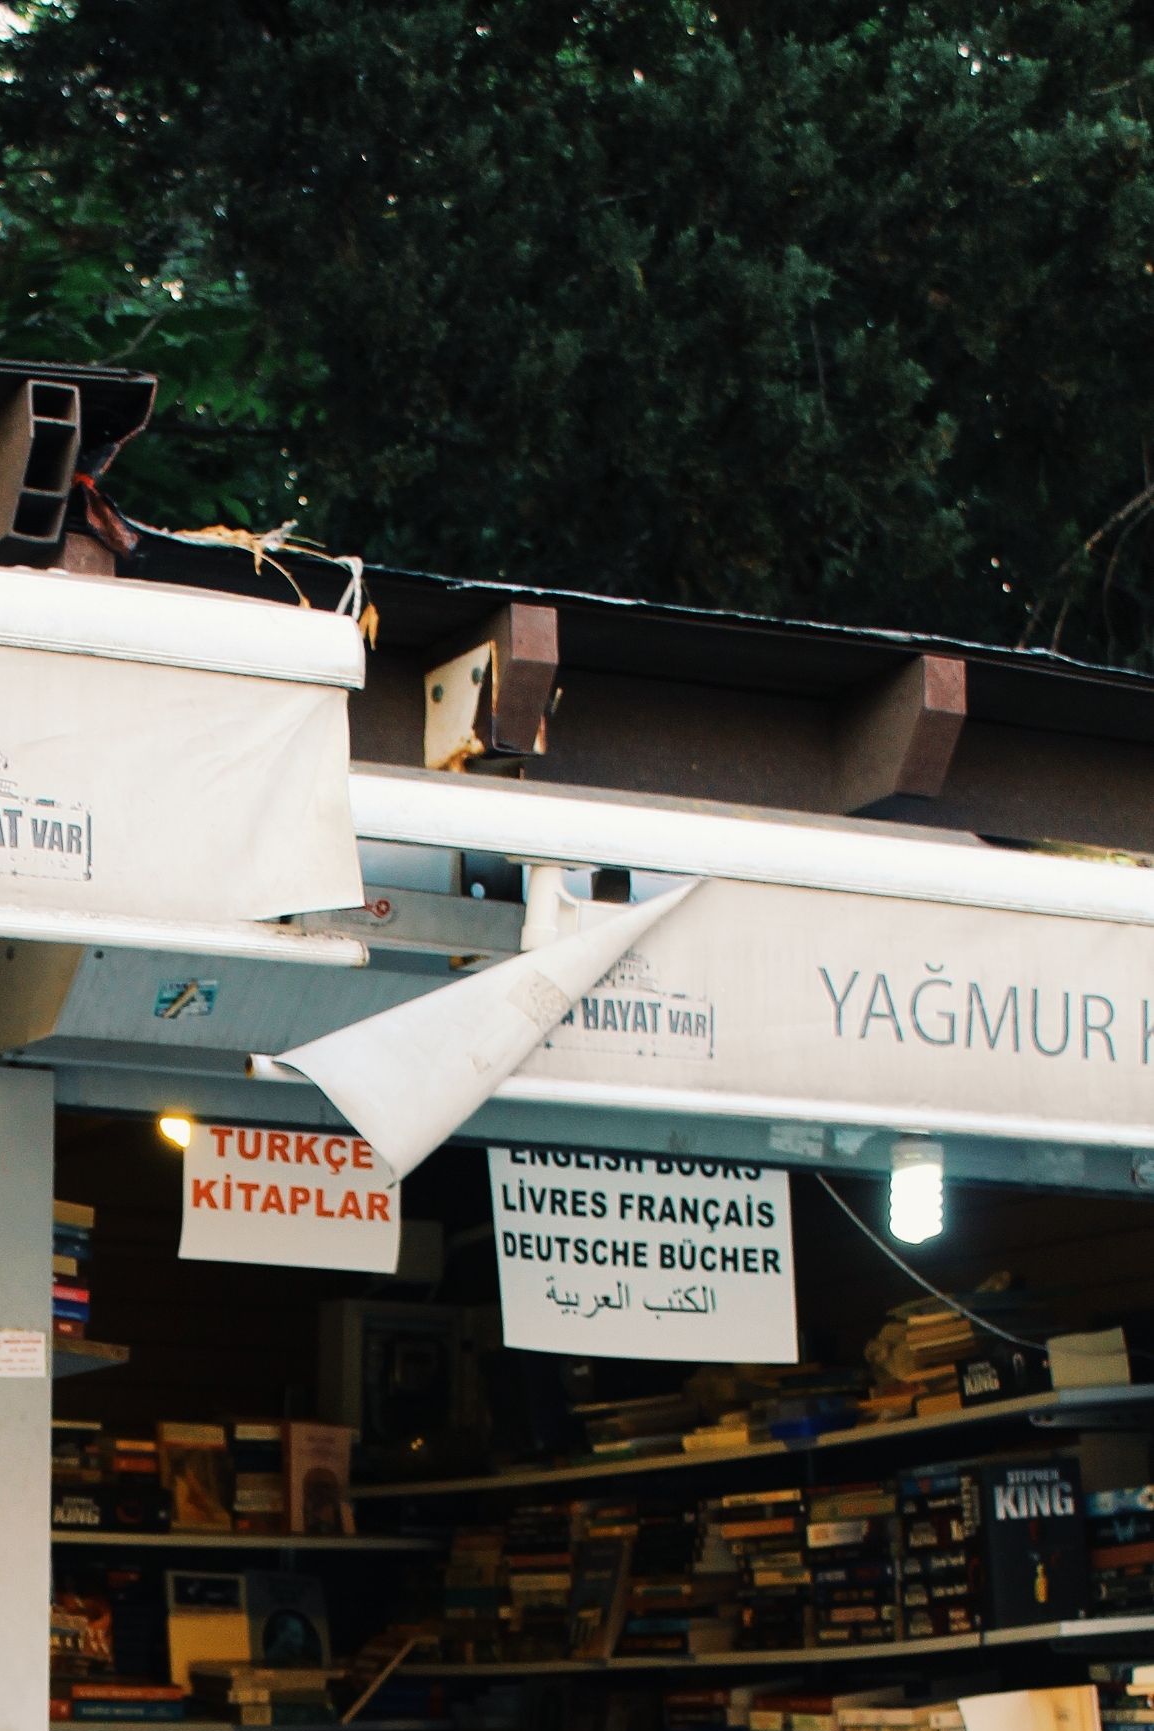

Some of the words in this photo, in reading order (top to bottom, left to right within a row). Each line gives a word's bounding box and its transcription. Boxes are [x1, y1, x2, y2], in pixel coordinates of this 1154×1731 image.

[30, 817, 83, 855] VAR
[581, 997, 661, 1035] HAYAT
[668, 1008, 707, 1039] VAR
[817, 961, 1117, 1063] YAĞMUR
[192, 1173, 392, 1223] KİTAPLAR
[501, 1178, 608, 1219] LİVRES
[619, 1193, 776, 1233] FRANÇAİS
[502, 1230, 649, 1269] DEUTSCHE
[659, 1238, 782, 1275] BÜCHER
[545, 1275, 631, 1319] العربية
[643, 1285, 717, 1321] الكتب
[994, 1482, 1075, 1521] KING
